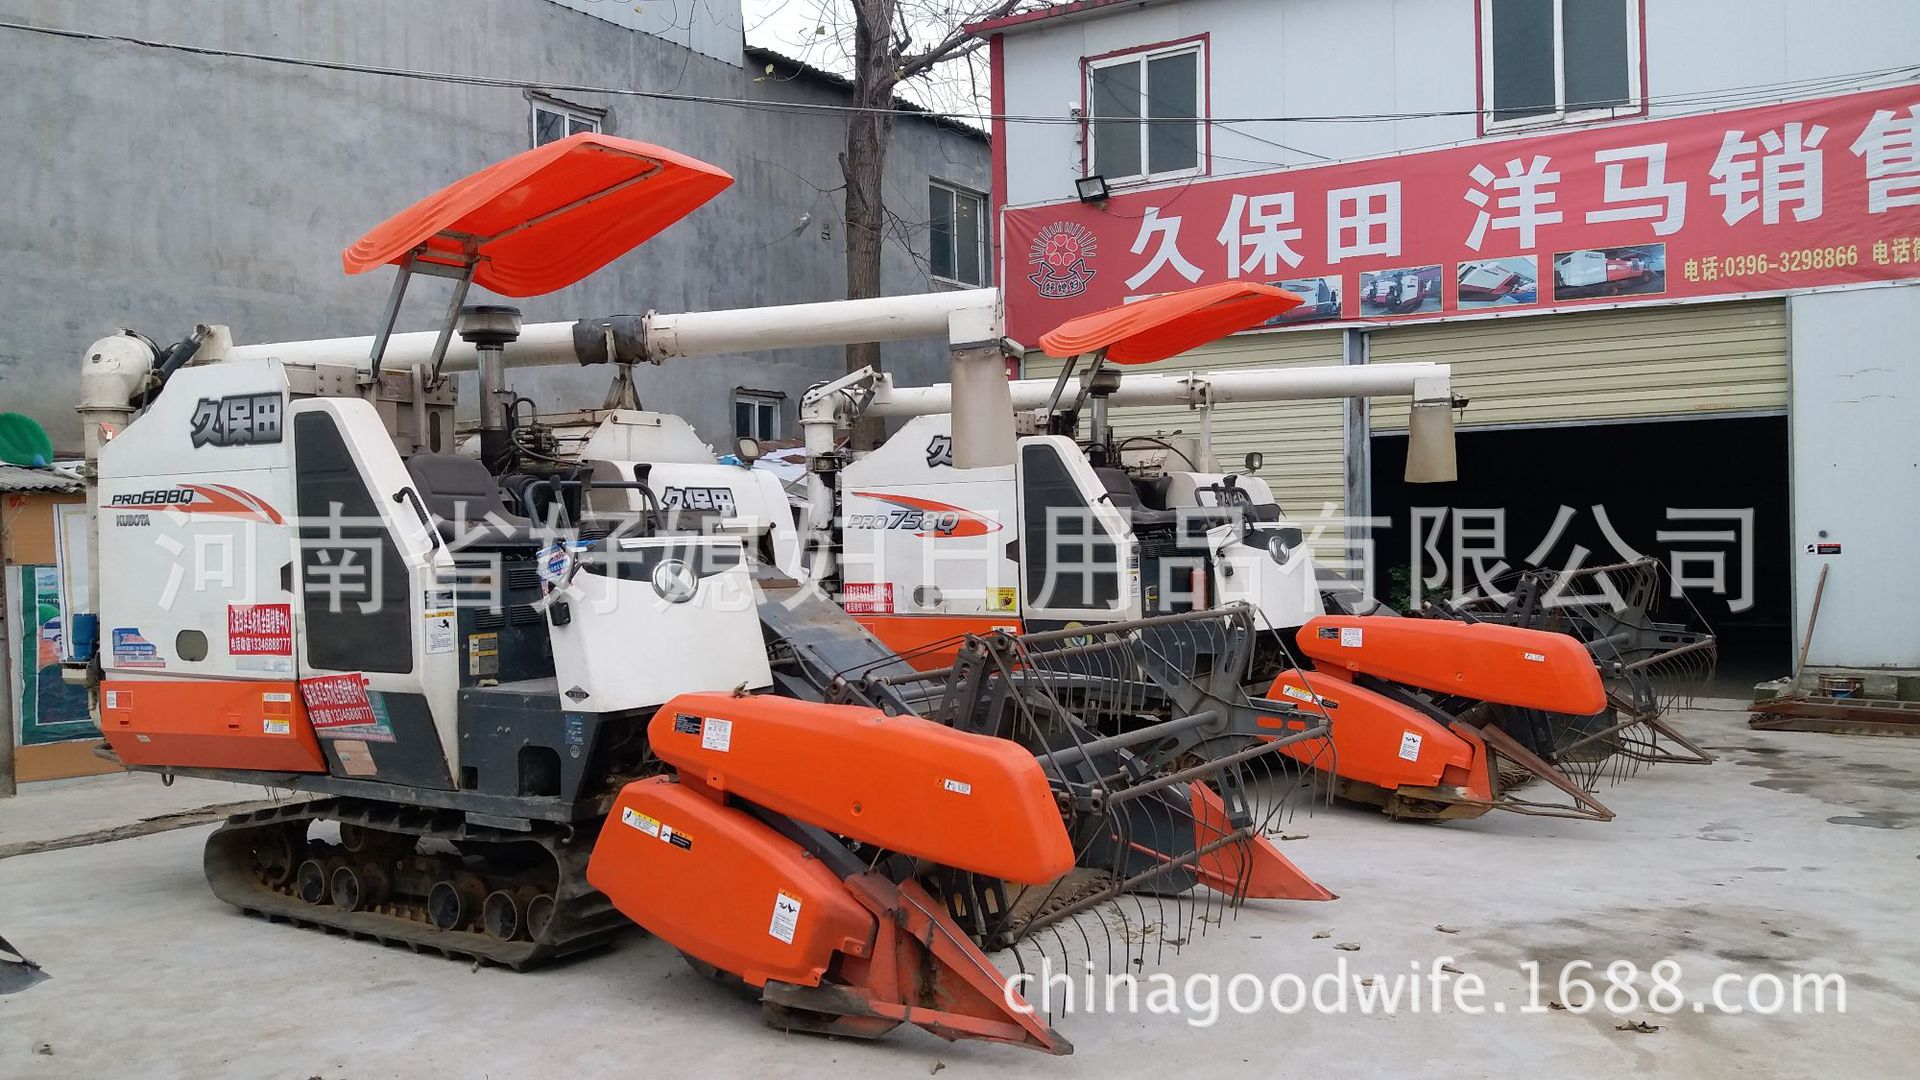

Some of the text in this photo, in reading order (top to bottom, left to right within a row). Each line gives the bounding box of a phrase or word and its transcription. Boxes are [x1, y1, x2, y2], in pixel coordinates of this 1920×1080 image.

[1124, 181, 1402, 291] 久保田
[1684, 244, 1859, 283] 电话:0396-3298866
[190, 391, 283, 449] 久保田
[112, 489, 194, 505] PRO688Q
[116, 514, 150, 527] KUBOTA
[847, 510, 960, 535] PRO758Q
